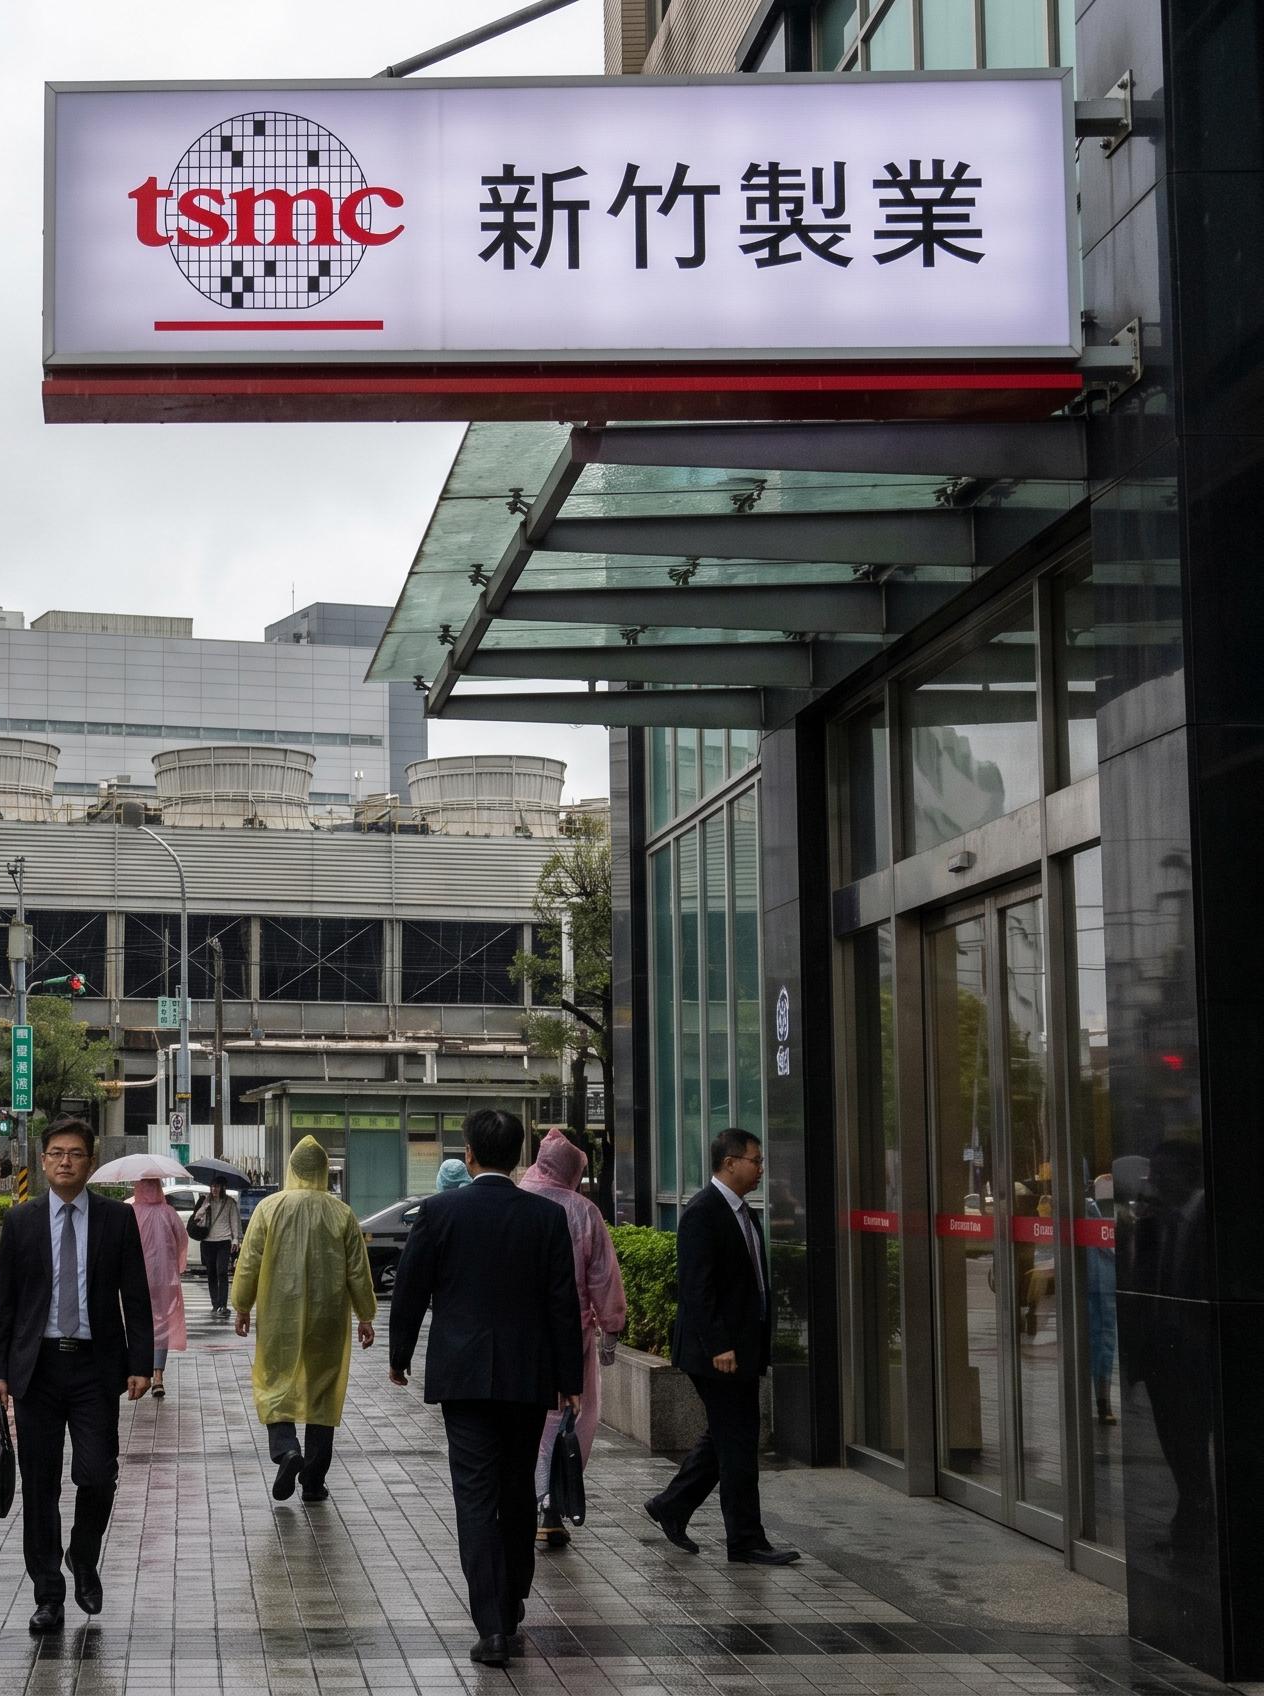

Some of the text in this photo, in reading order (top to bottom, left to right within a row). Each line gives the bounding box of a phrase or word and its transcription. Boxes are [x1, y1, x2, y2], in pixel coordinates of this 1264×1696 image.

[129, 177, 405, 247] tsmc
[479, 159, 986, 270] 新竹製業
